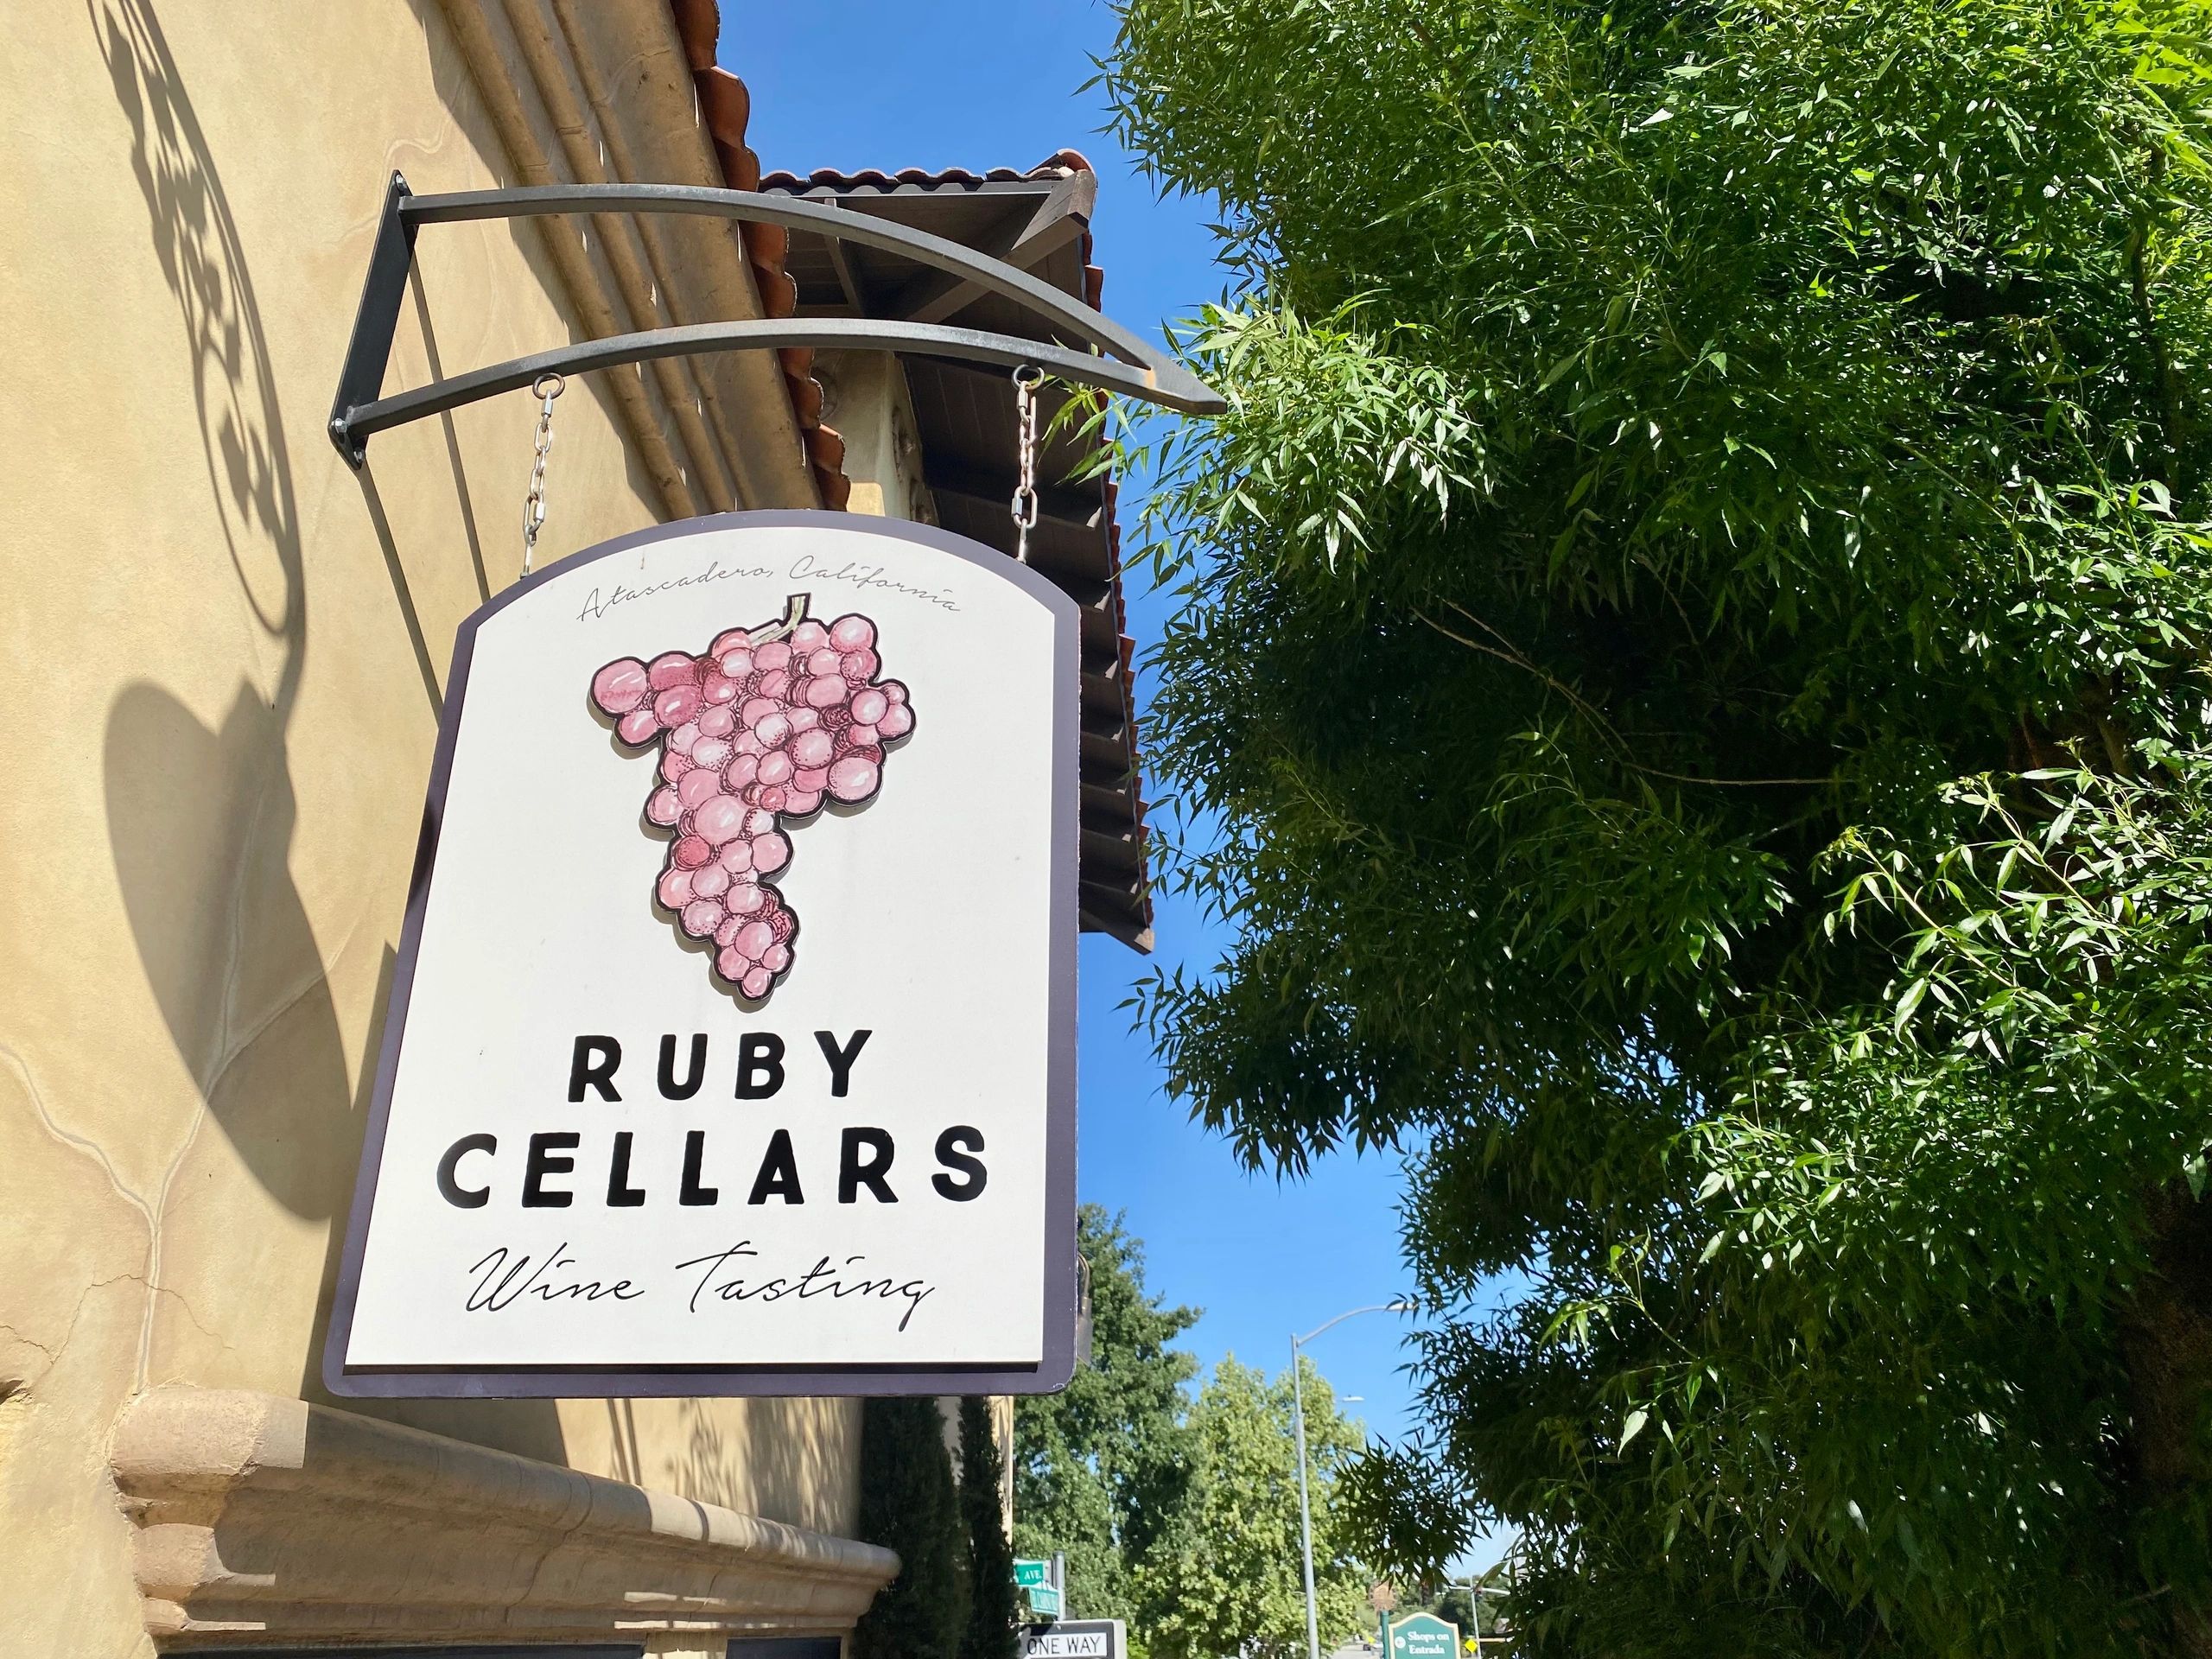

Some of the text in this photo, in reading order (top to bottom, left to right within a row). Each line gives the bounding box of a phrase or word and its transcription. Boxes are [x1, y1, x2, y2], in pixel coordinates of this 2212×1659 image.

[576, 555, 962, 622] Atascadero, California
[567, 1029, 873, 1103] RUBY
[436, 1125, 988, 1209] CELLARS
[465, 1240, 937, 1333] Wine Tasting
[1027, 1636, 1101, 1656] ONE WAY
[1407, 1630, 1435, 1643] Shops
[1408, 1643, 1446, 1655] Entrada
